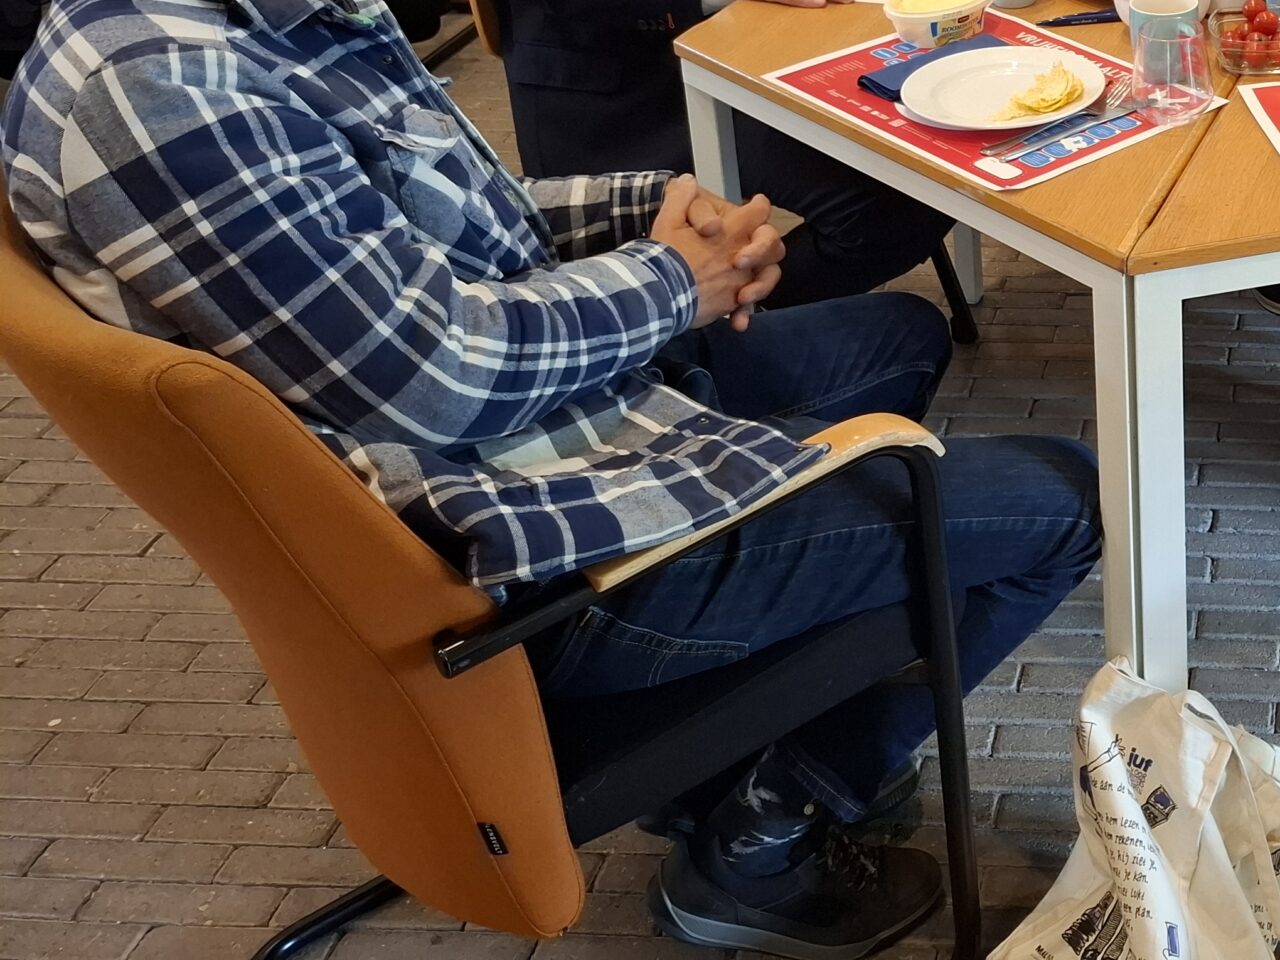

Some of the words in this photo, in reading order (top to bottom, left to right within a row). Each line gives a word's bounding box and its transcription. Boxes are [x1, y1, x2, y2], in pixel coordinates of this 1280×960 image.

[1127, 747, 1153, 772] juf
[1117, 782, 1125, 793] de
[1120, 817, 1140, 830] lezen
[1115, 834, 1146, 850] rekenen,
[1117, 849, 1129, 866] hij
[1132, 853, 1146, 867] ziet
[1123, 869, 1130, 882] je
[1130, 885, 1145, 900] lukt
[1135, 905, 1153, 920] plan.
